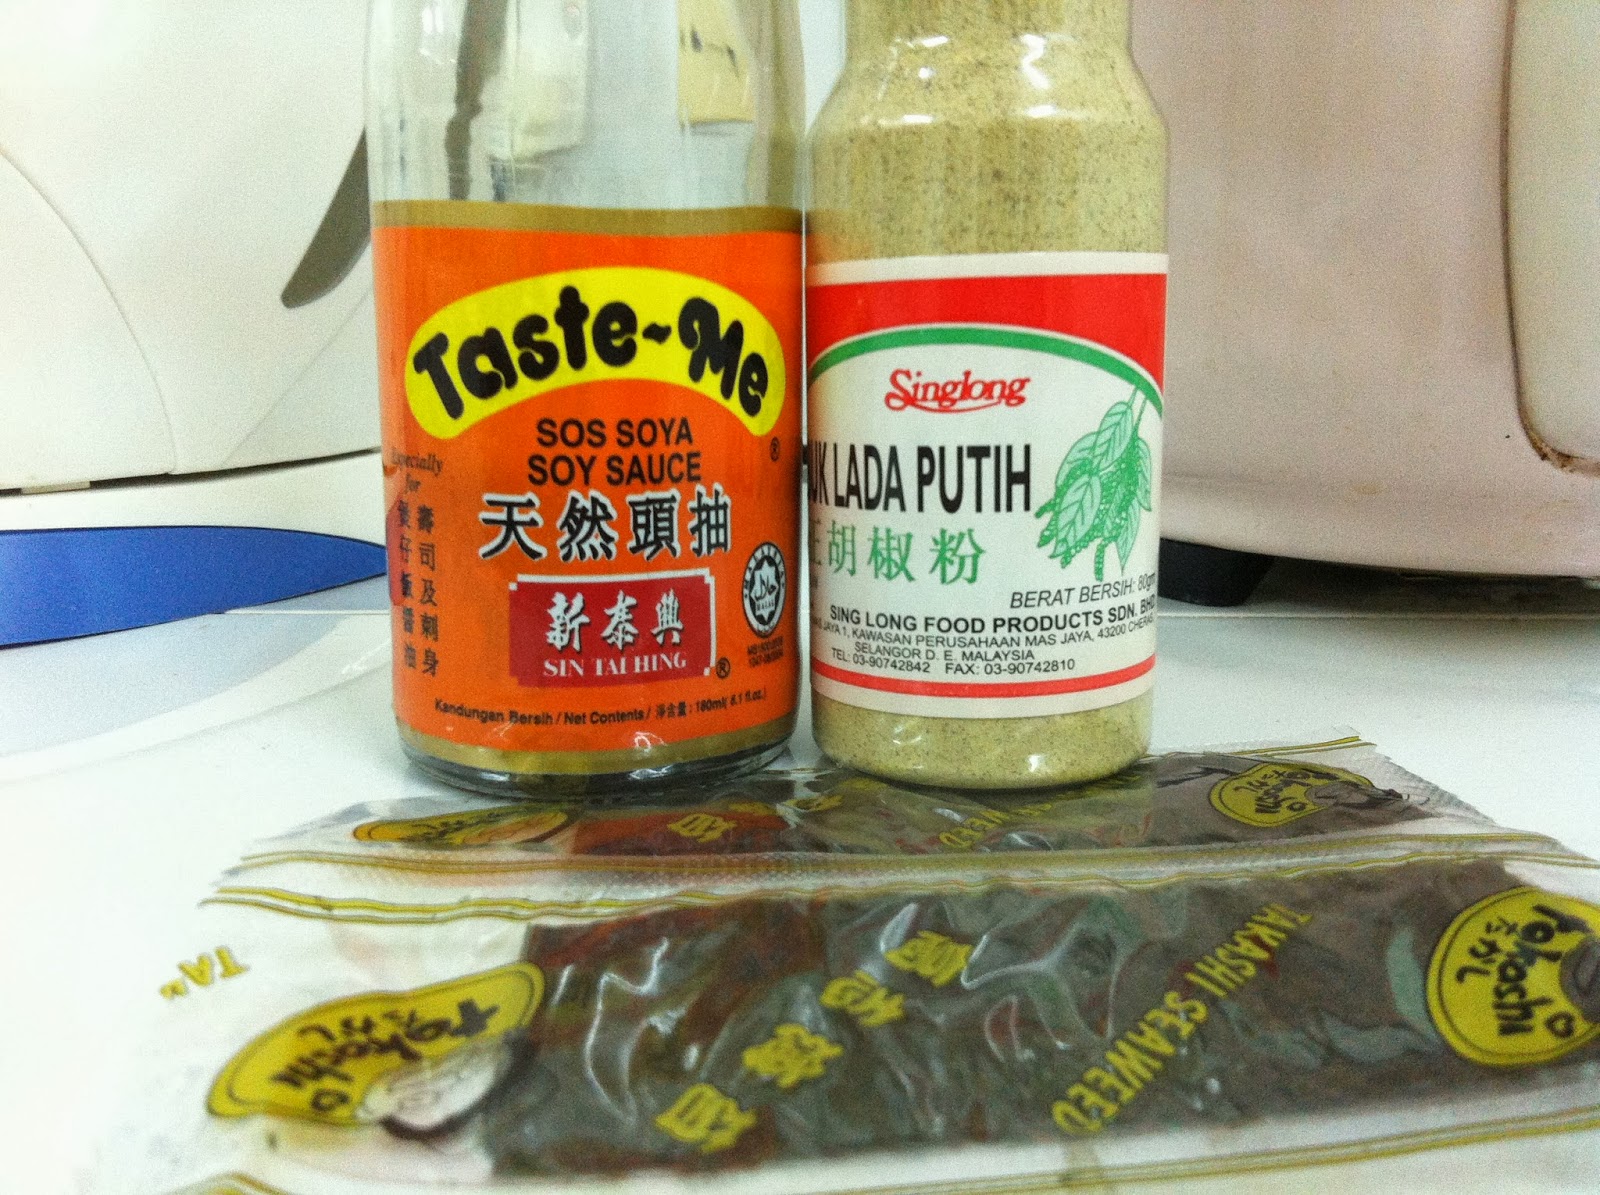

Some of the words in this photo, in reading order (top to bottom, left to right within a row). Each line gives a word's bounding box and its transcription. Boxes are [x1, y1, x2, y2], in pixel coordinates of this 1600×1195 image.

[884, 369, 1031, 413] Singlong
[536, 418, 606, 447] SOS
[616, 417, 693, 447] SOYA
[527, 455, 596, 486] SOY
[606, 452, 702, 486] SAUCE
[833, 443, 907, 512] LADA
[917, 444, 1031, 514] PUTIH
[478, 483, 732, 563] 天然頭抽
[1010, 588, 1075, 609] BERAT
[1079, 580, 1135, 604] BERSIH:
[830, 604, 861, 625] SING
[866, 612, 917, 632] LONG
[924, 617, 985, 634] FOOD
[993, 609, 1103, 634] PRODUCTS
[1108, 602, 1138, 624] SDN.
[852, 628, 912, 646] KAWASAN
[915, 635, 1020, 649] PERUSAHAAN
[1025, 634, 1057, 647] MAS
[1060, 630, 1094, 645] JAYA,
[1097, 622, 1126, 639] 43200
[543, 658, 584, 677] SIN
[595, 656, 627, 676] TAI
[634, 652, 687, 674] HING
[831, 647, 851, 662] TEL:
[853, 653, 931, 673] 03-90742842
[945, 662, 980, 675] FAX:
[984, 658, 1076, 676] 03-90742810
[854, 641, 921, 660] SELANGOR
[961, 650, 1035, 662] MALAYSIA
[434, 698, 505, 724] Kandungan
[509, 709, 554, 725] Bersih
[564, 711, 587, 725] Net
[590, 707, 645, 725] Contents
[1185, 903, 1313, 999] TAKASHI
[1052, 991, 1209, 1135] SEAWEED
